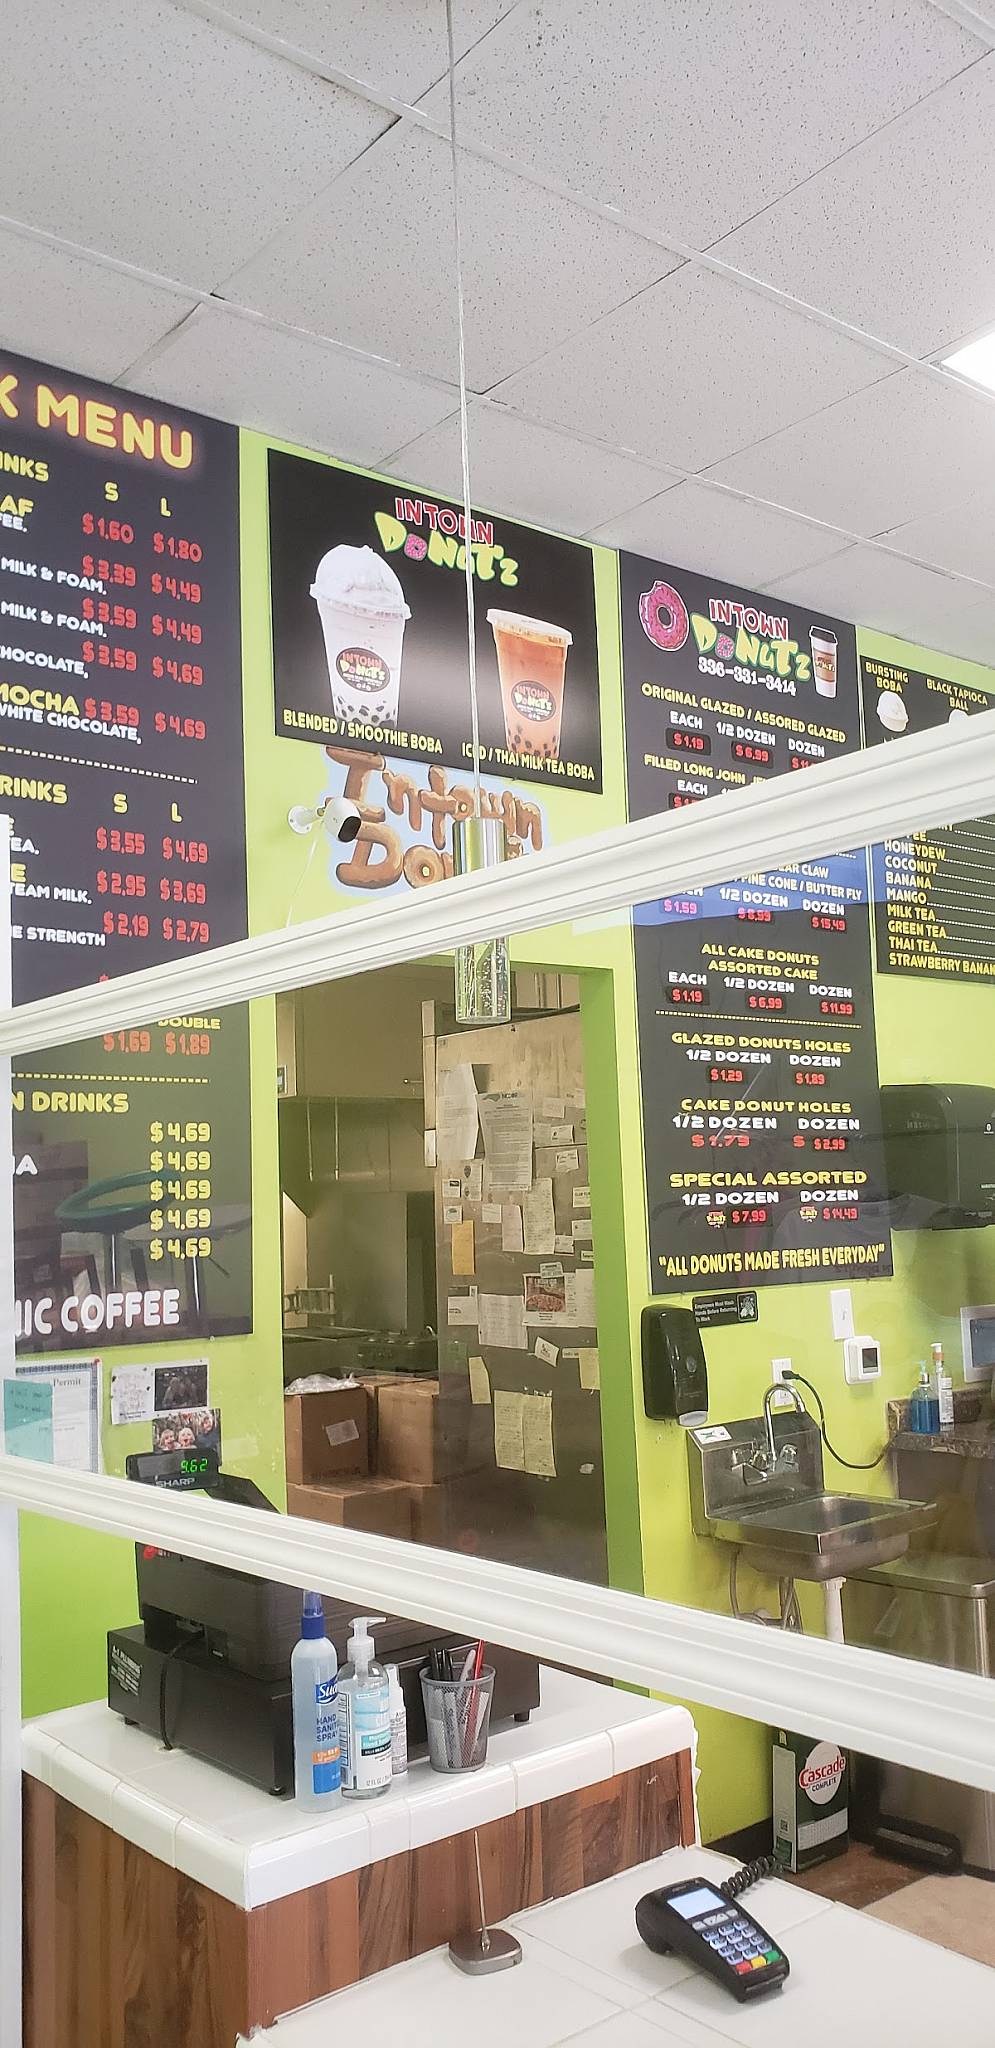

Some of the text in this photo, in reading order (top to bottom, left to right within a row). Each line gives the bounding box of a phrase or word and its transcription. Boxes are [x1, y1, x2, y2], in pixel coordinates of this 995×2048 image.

[37, 384, 193, 469] MENU
[104, 481, 171, 518] S L
[1, 556, 37, 578] MILK
[41, 566, 54, 581] &
[1, 599, 37, 621] MILK
[41, 609, 54, 624] &
[708, 599, 789, 641] INTOWN
[0, 645, 88, 679] HOCOLATE,
[866, 662, 909, 683] BURSTING
[698, 657, 796, 696] 336-331-3414
[877, 677, 903, 693] BOBA
[926, 678, 988, 706] BLACK TAPIOCA
[641, 682, 698, 708] ORIGINAL
[700, 697, 744, 718] GLAZED
[754, 709, 805, 734] ASSORED
[807, 724, 846, 744] GLAZED
[949, 697, 969, 711] BALL
[283, 709, 338, 734] BLENDED
[348, 722, 408, 747] SMOOTHIE
[411, 734, 442, 753] BOBA
[670, 711, 825, 758] EACH 1/2 DOZEN DOZEN
[462, 742, 595, 780] ICD THAI MILK TEA BOBA
[644, 754, 681, 772] FILLED
[683, 761, 714, 779] LONG
[716, 769, 745, 785] JOHN
[677, 779, 708, 796] EACH
[113, 793, 128, 814] S
[171, 802, 182, 823] L
[884, 840, 946, 861] HONEYDEW
[802, 864, 828, 879] CLAW
[885, 856, 938, 874] COCONUT
[768, 876, 862, 901] CONE BUTTER FLY
[885, 871, 932, 890] BANANA
[720, 888, 740, 901] 1/2
[743, 891, 788, 908] DOZEN
[802, 899, 845, 915] DOZEN
[886, 887, 927, 905] MANGO
[887, 903, 936, 922] MILK TEA
[26, 926, 106, 946] STRENGTH
[888, 920, 947, 938] GREEN TEA
[701, 943, 819, 966] ALL CAKE DONUTS
[888, 936, 938, 953] THAI TEA
[708, 960, 818, 981] ASSORTED CAKE
[889, 953, 960, 971] STRAWBERRY
[668, 971, 853, 999] EACH 1/2 DOZEN DOZEN
[671, 1032, 851, 1053] GLAZED DONUTS HOLES
[686, 1049, 841, 1067] 1/2 DOZEN DOZEN
[32, 1091, 128, 1113] DRINKS
[681, 1099, 851, 1114] CAKE DONUT HOLES
[672, 1115, 860, 1131] 1/2 DOZEN DOZEN
[669, 1170, 867, 1188] SPECIAL ASSORTED
[682, 1189, 859, 1206] 1/2 DOZEN DOZEN
[691, 1252, 742, 1275] DONUTS
[745, 1250, 780, 1272] MADE
[782, 1247, 820, 1269] FRESH
[61, 1288, 180, 1335] COFFEE
[54, 1378, 81, 1387] Permit
[181, 1458, 208, 1473] 9.62
[156, 1477, 195, 1488] SHARP
[316, 1714, 337, 1725] HAND
[800, 1755, 845, 1787] Cascade
[811, 1776, 837, 1792] COMPLETE
